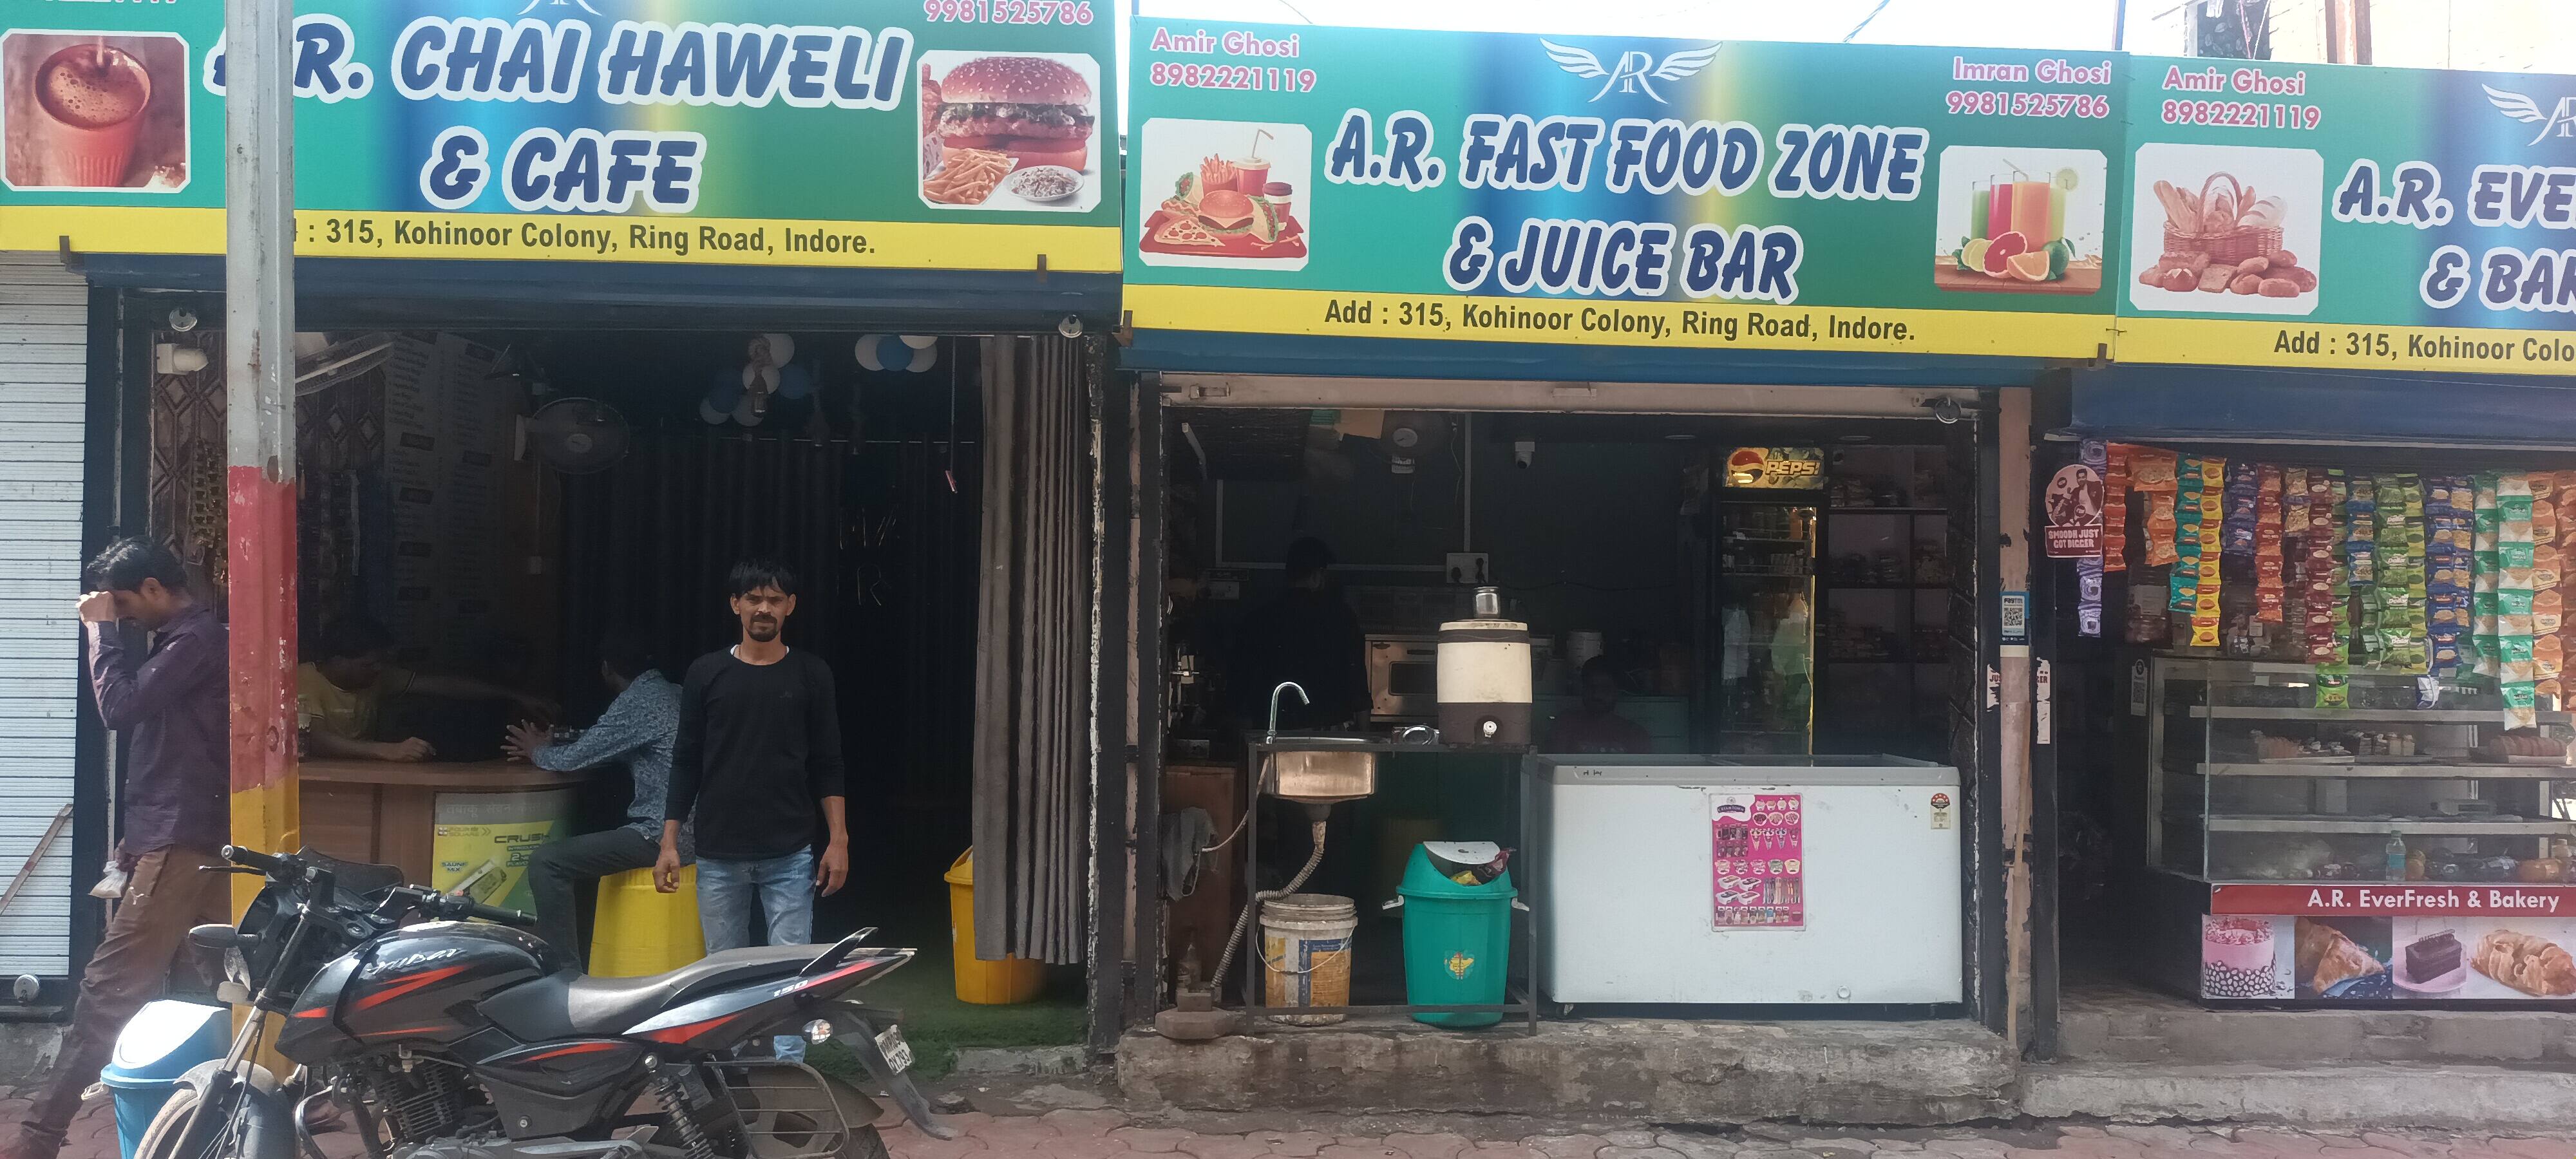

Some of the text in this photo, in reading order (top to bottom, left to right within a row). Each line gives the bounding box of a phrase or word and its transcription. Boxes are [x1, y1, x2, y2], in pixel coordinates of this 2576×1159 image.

[925, 0, 1092, 24] 9981525786
[1151, 28, 1300, 58] Amir Ghosi
[401, 24, 582, 94] CHAI
[606, 28, 905, 104] HAWELI
[1150, 62, 1317, 93] 8982221119
[1953, 57, 2112, 86] Imran Ghosi
[2163, 66, 2306, 96] Amir Ghosi
[1946, 90, 2110, 120] 9981525786
[2161, 99, 2322, 130] 8982221119
[429, 135, 699, 205] & CAFE
[1331, 113, 1925, 196] A.R. FAST FOOD ZONE
[2338, 165, 2447, 223] A.R.
[326, 218, 383, 249] 315,
[394, 219, 513, 247] Kohinoor
[520, 222, 619, 255] Colony,
[629, 225, 688, 256] Ring
[700, 227, 775, 256] Road,
[785, 228, 876, 255] Indore.
[1450, 222, 1798, 301] & JUICE BAR
[2426, 252, 2470, 303] &
[1325, 298, 1372, 325] Add
[1399, 301, 1453, 333] 315,
[1463, 303, 1574, 332] Kohinoor
[1580, 306, 1671, 340] Colony,
[1682, 310, 1738, 342] Ring
[1747, 312, 1818, 343] Road,
[1829, 314, 1916, 341] Indore.
[2274, 329, 2320, 354] Add
[2345, 332, 2398, 361] 315,
[2408, 334, 2515, 361] Kohinoor
[2522, 337, 2576, 362] Colo
[1765, 460, 1821, 476] PEPSI
[2053, 539, 2067, 549] GOT
[2078, 529, 2099, 539] JUST
[2307, 889, 2559, 913] A.R. EverFresh & Bakery
